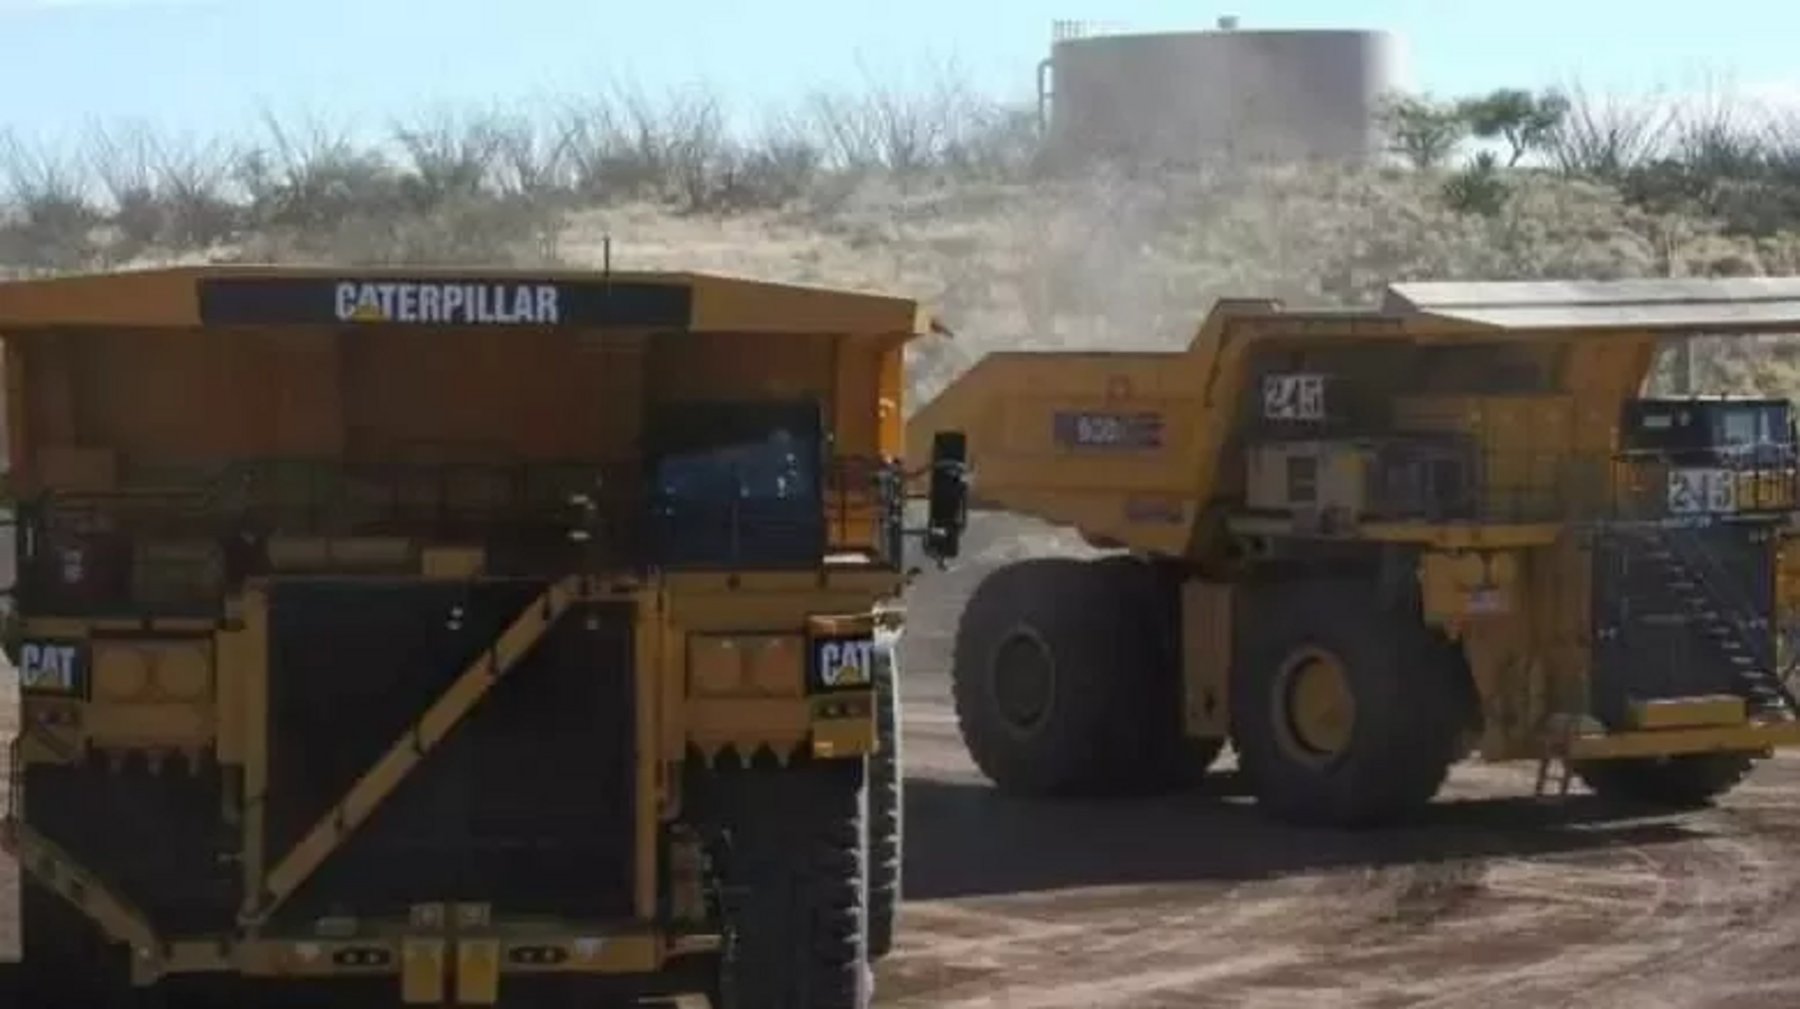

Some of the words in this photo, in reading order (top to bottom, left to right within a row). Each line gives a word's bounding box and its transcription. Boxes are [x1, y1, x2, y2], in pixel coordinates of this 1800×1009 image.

[334, 282, 558, 324] CATERPILLAR
[20, 644, 75, 690] CAT
[821, 641, 875, 686] CAT
